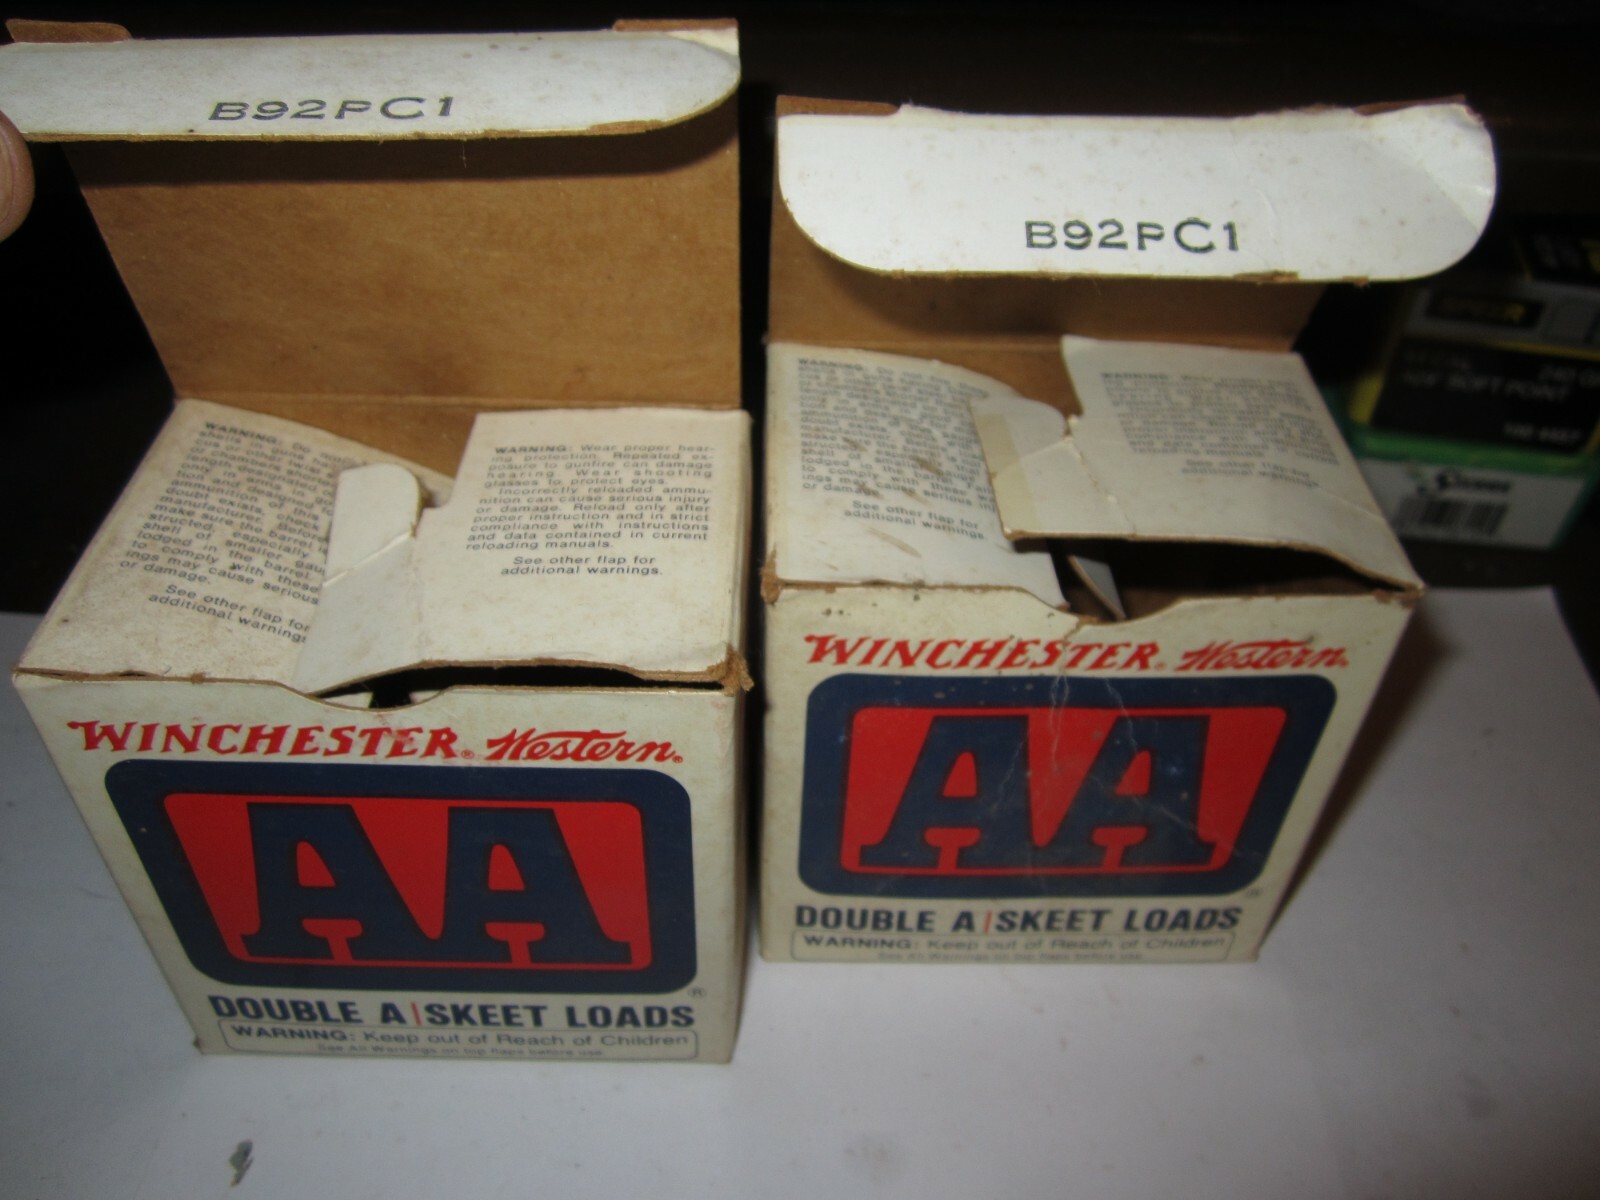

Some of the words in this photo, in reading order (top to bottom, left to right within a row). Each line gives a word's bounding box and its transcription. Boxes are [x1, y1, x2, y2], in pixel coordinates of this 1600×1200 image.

[208, 96, 454, 121] B92PC1
[1025, 217, 1239, 254] B92PC1
[580, 444, 615, 452] Wear
[623, 444, 669, 452] proper
[490, 455, 512, 463] ing
[612, 452, 679, 460] Repeated
[487, 463, 536, 471] posure
[543, 461, 557, 469] to
[564, 461, 614, 469] gunfire
[655, 461, 711, 469] damage
[633, 469, 711, 478] shooting
[483, 480, 537, 488] glasses
[547, 478, 561, 486] to
[570, 478, 621, 486] protect
[498, 487, 577, 495] Incorrectly
[587, 486, 652, 494] reloaded
[478, 496, 520, 504] nition
[558, 495, 601, 503] cause
[668, 496, 709, 504] injury
[475, 506, 490, 514] or
[573, 503, 624, 511] Reload
[634, 503, 665, 511] only
[675, 504, 708, 512] after
[472, 515, 521, 523] proper
[529, 513, 608, 521] instruction
[615, 512, 643, 520] and
[650, 512, 663, 520] in
[670, 513, 707, 521] strict
[470, 523, 557, 531] compliance
[572, 522, 602, 530] with
[618, 522, 707, 530] instructions
[467, 533, 495, 541] and
[503, 532, 536, 540] data
[545, 531, 620, 539] contained
[629, 531, 643, 539] in
[651, 533, 706, 541] current
[465, 542, 538, 550] reloading
[512, 556, 542, 564] See
[548, 556, 589, 564] other
[596, 555, 625, 564] flap
[633, 555, 654, 564] for
[500, 566, 579, 574] additional
[804, 633, 1157, 671] WINCHESTER
[1174, 639, 1341, 672] Western
[67, 719, 458, 758] WINCHESTER
[485, 728, 673, 763] Western
[859, 715, 1217, 868] AA
[240, 801, 633, 965] AA
[795, 906, 935, 932] DOUBLE
[952, 911, 975, 932] A
[995, 909, 1110, 932] SKEET
[1123, 907, 1243, 932] LOADS
[928, 939, 979, 950] Keep
[986, 940, 1016, 950] out
[1024, 939, 1043, 950] of
[1050, 939, 1112, 950] Reach
[1121, 939, 1137, 950] of
[1146, 937, 1224, 949] Children
[207, 995, 363, 1024] DOUBLE
[380, 1002, 407, 1024] A
[424, 1004, 548, 1027] SKEET
[567, 1005, 694, 1028] LOADS
[231, 1024, 355, 1041] WARNING:
[363, 1031, 420, 1044] Keep
[428, 1033, 460, 1044] out
[468, 1033, 487, 1044] of
[497, 1034, 564, 1046] Reach
[573, 1035, 592, 1046] of
[601, 1034, 688, 1045] Children
